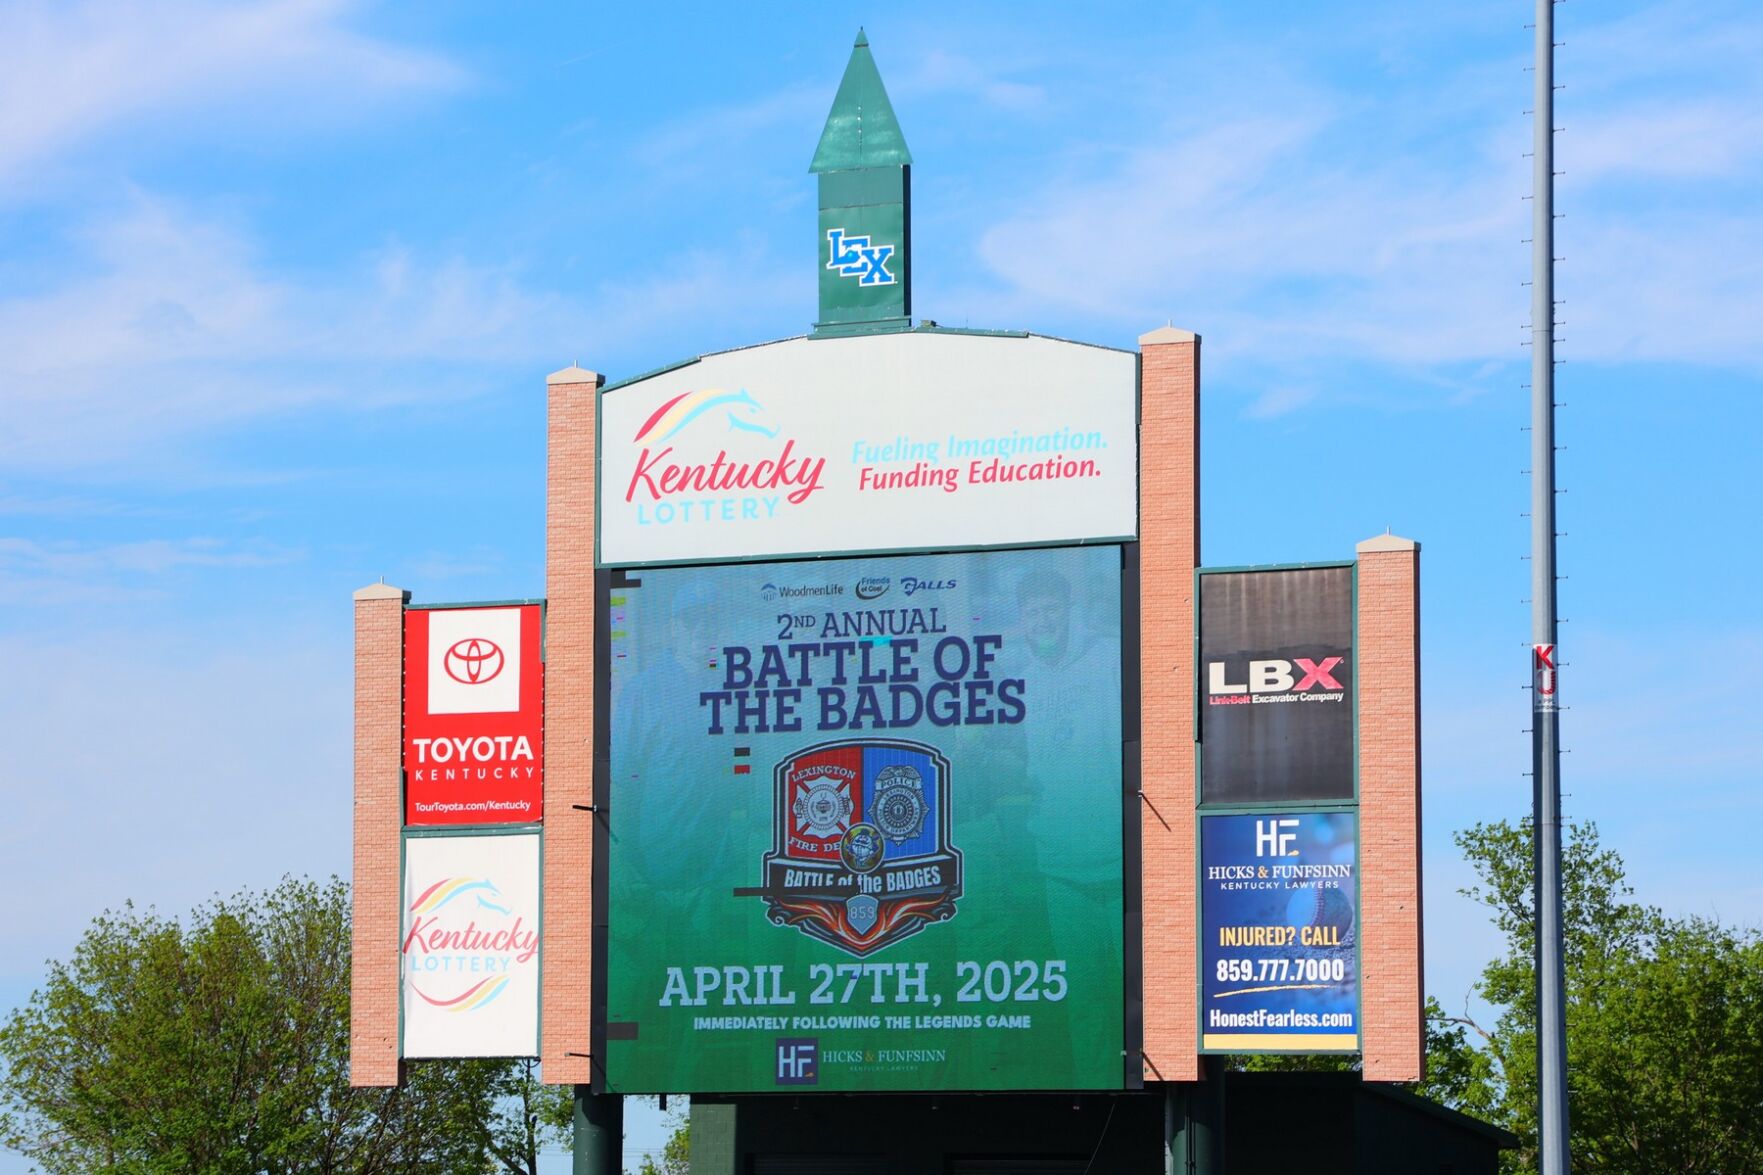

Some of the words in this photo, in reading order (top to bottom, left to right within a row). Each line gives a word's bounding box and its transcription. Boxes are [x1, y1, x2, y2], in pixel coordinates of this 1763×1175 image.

[827, 228, 895, 287] LEX
[851, 437, 939, 465] Fueling
[947, 427, 1108, 461] Imagination.
[625, 439, 826, 505] Kentucky
[858, 463, 959, 493] Funding
[967, 454, 1102, 485] Education.
[638, 496, 779, 526] LOTTERY
[779, 583, 844, 598] WoodmenLife
[777, 612, 816, 640] 2ND
[820, 607, 947, 638] ANNUAL
[723, 638, 919, 690] BATTLE
[933, 634, 1002, 682] OF
[1209, 656, 1344, 694] LBX
[700, 687, 802, 735] THE
[816, 678, 1027, 731] BADGES
[1251, 694, 1299, 704] Excavator
[1299, 692, 1344, 702] Company
[413, 736, 534, 763] TOYOTA
[415, 767, 534, 781] KENTUCKY
[792, 765, 856, 782] LEXINGTON
[415, 800, 531, 817] TourToyota.com/Kentucky
[788, 836, 818, 852] FIRE
[1256, 819, 1300, 857] HF
[857, 873, 882, 893] the
[886, 865, 942, 892] BADGES
[1208, 865, 1255, 880] HICKS
[1257, 865, 1269, 879] &
[1272, 864, 1351, 880] FUNFSINN
[1220, 881, 1280, 890] KENTUCKY
[1285, 880, 1339, 889] LAWYERS
[850, 906, 875, 920] 859
[402, 916, 540, 964] Kentucky
[1219, 926, 1296, 946] INJURED?
[1301, 926, 1340, 946] CALL
[411, 955, 512, 973] LOTTERY
[1216, 958, 1344, 983] 859.777.7000
[659, 965, 796, 1007] APRIL
[808, 962, 943, 1007] 27TH,
[956, 960, 1068, 1002] 2025
[693, 1016, 788, 1030] IMMEDIATELY
[792, 1016, 880, 1030] FOLLOWING
[885, 1015, 911, 1029] THE
[915, 1015, 982, 1029] LEGENDS
[986, 1015, 1031, 1029] GAME
[1210, 1008, 1352, 1028] HonestFearless.com
[778, 1045, 815, 1078] HF
[823, 1050, 863, 1063] HICKS
[865, 1050, 874, 1063] &
[878, 1049, 946, 1063] FUNFSINN
